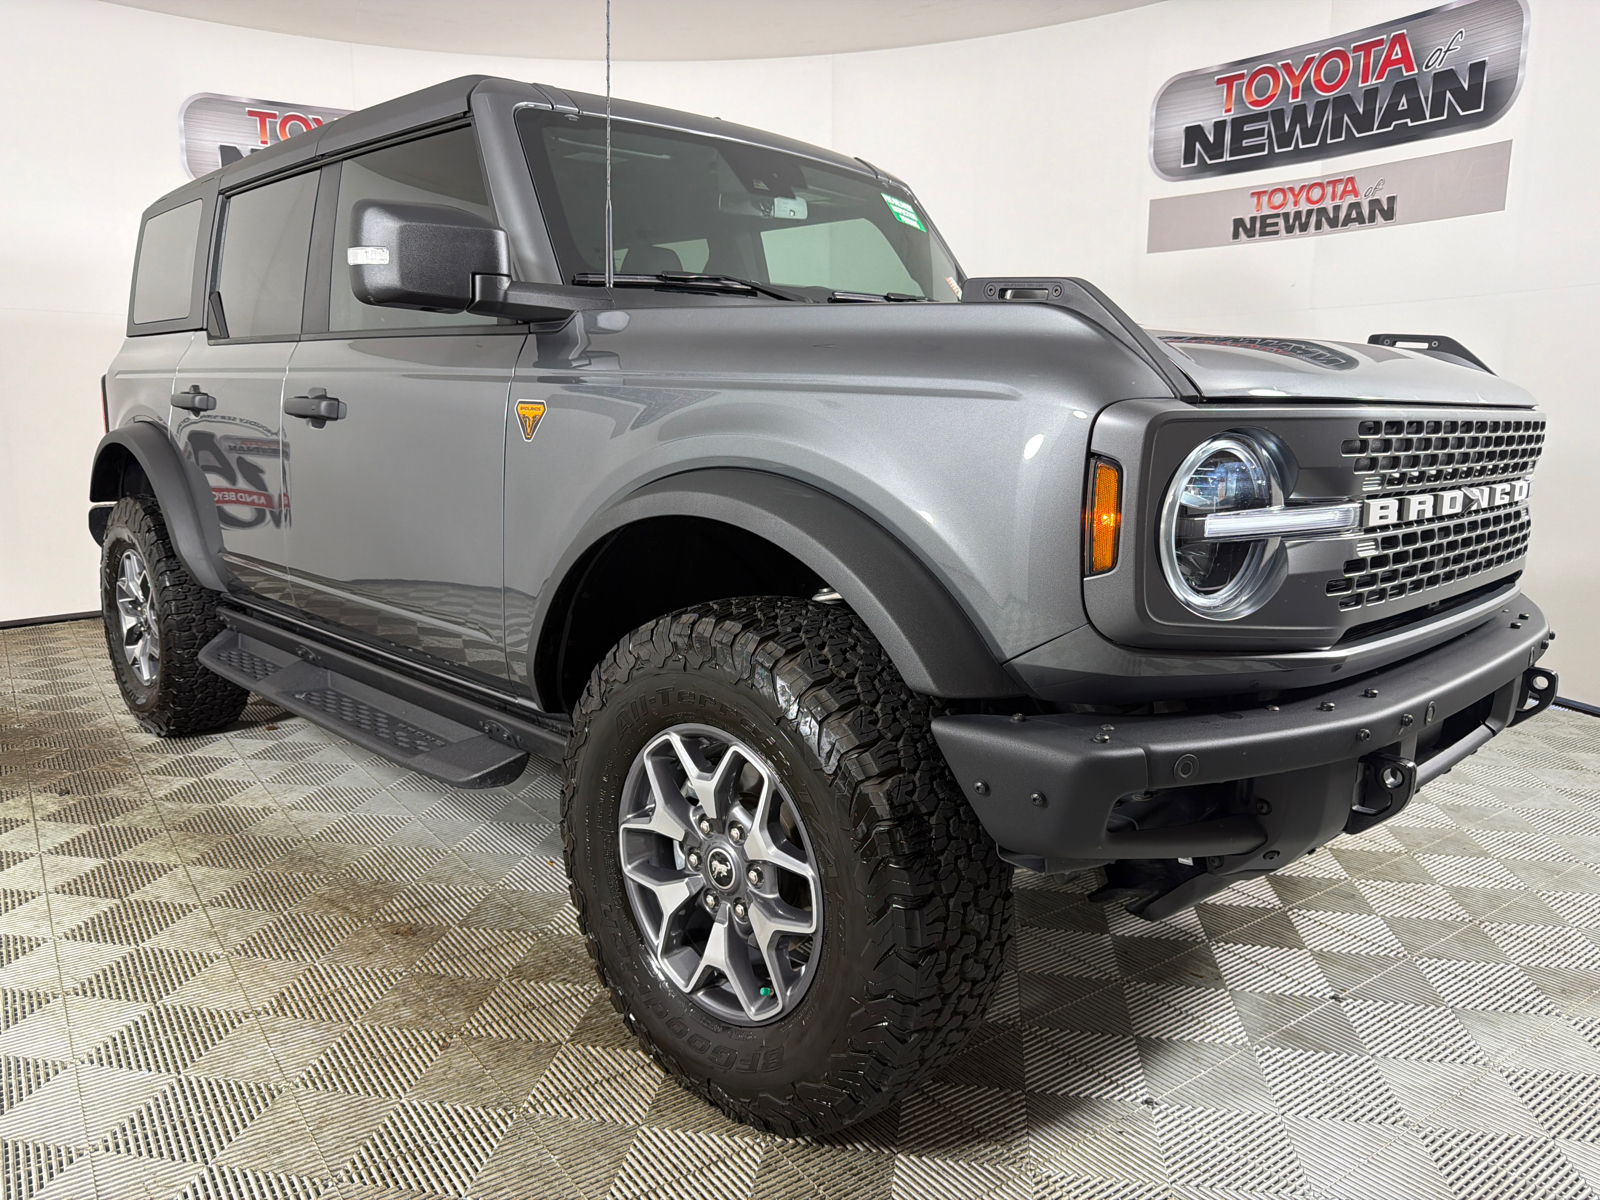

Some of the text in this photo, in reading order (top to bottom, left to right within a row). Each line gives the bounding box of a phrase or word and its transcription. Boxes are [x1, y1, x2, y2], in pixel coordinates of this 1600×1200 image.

[1216, 29, 1465, 114] TOYOTA of
[1182, 60, 1487, 167] NEWNAN
[1251, 176, 1385, 212] TOYOTA of
[1232, 195, 1397, 241] NEWNAN
[1364, 480, 1529, 527] BRONCO
